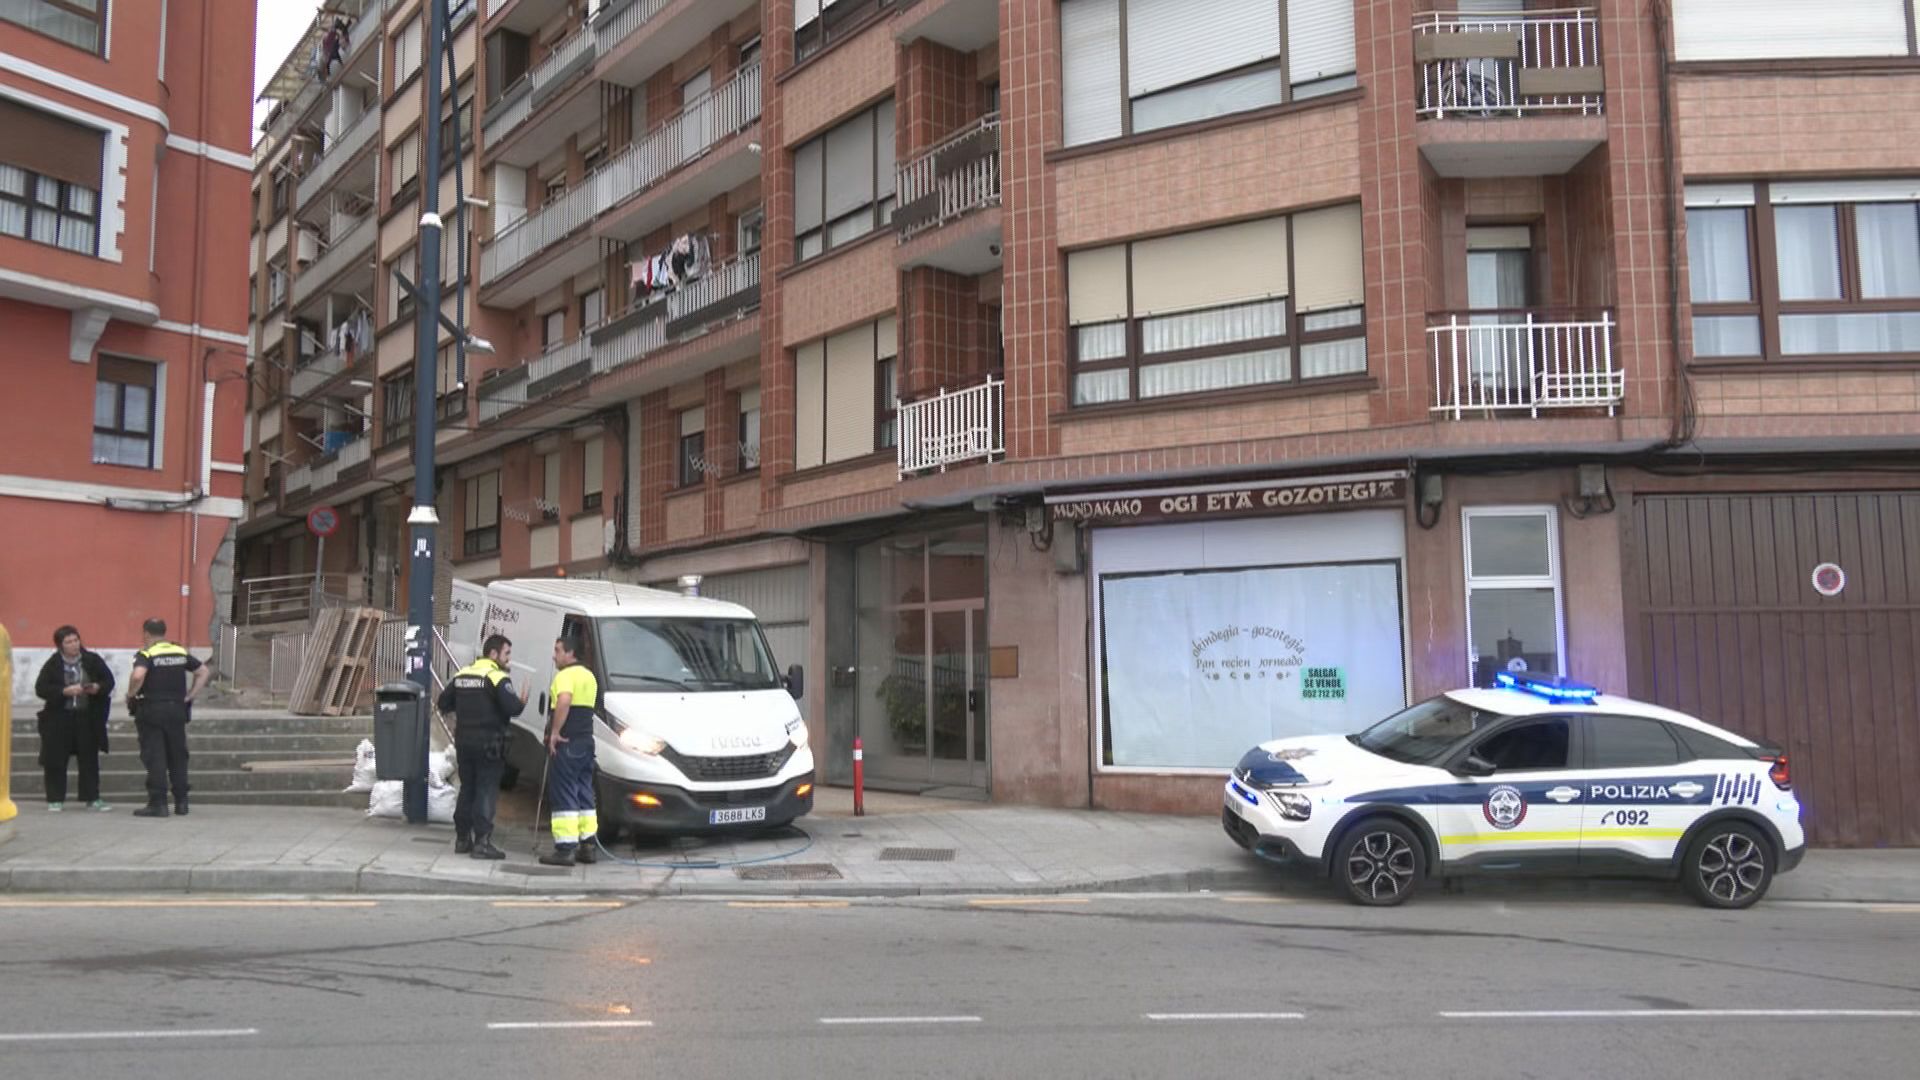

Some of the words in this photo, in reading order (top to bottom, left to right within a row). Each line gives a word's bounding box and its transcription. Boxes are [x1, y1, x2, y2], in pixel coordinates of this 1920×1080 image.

[1053, 499, 1142, 518] MUNDAKAKO
[1160, 495, 1198, 513] OGI
[1206, 491, 1253, 511] ETA
[1262, 481, 1395, 507] GOZOTEGIA
[1251, 626, 1305, 654] gozotegia
[1196, 658, 1215, 672] Pan
[1308, 667, 1336, 678] SALGAI
[1304, 678, 1314, 688] SE
[1315, 678, 1341, 688] VENDE
[1318, 689, 1330, 698] 712
[1591, 784, 1669, 799] POLIZIA
[745, 808, 764, 820] LKS
[1616, 809, 1649, 826] 092
